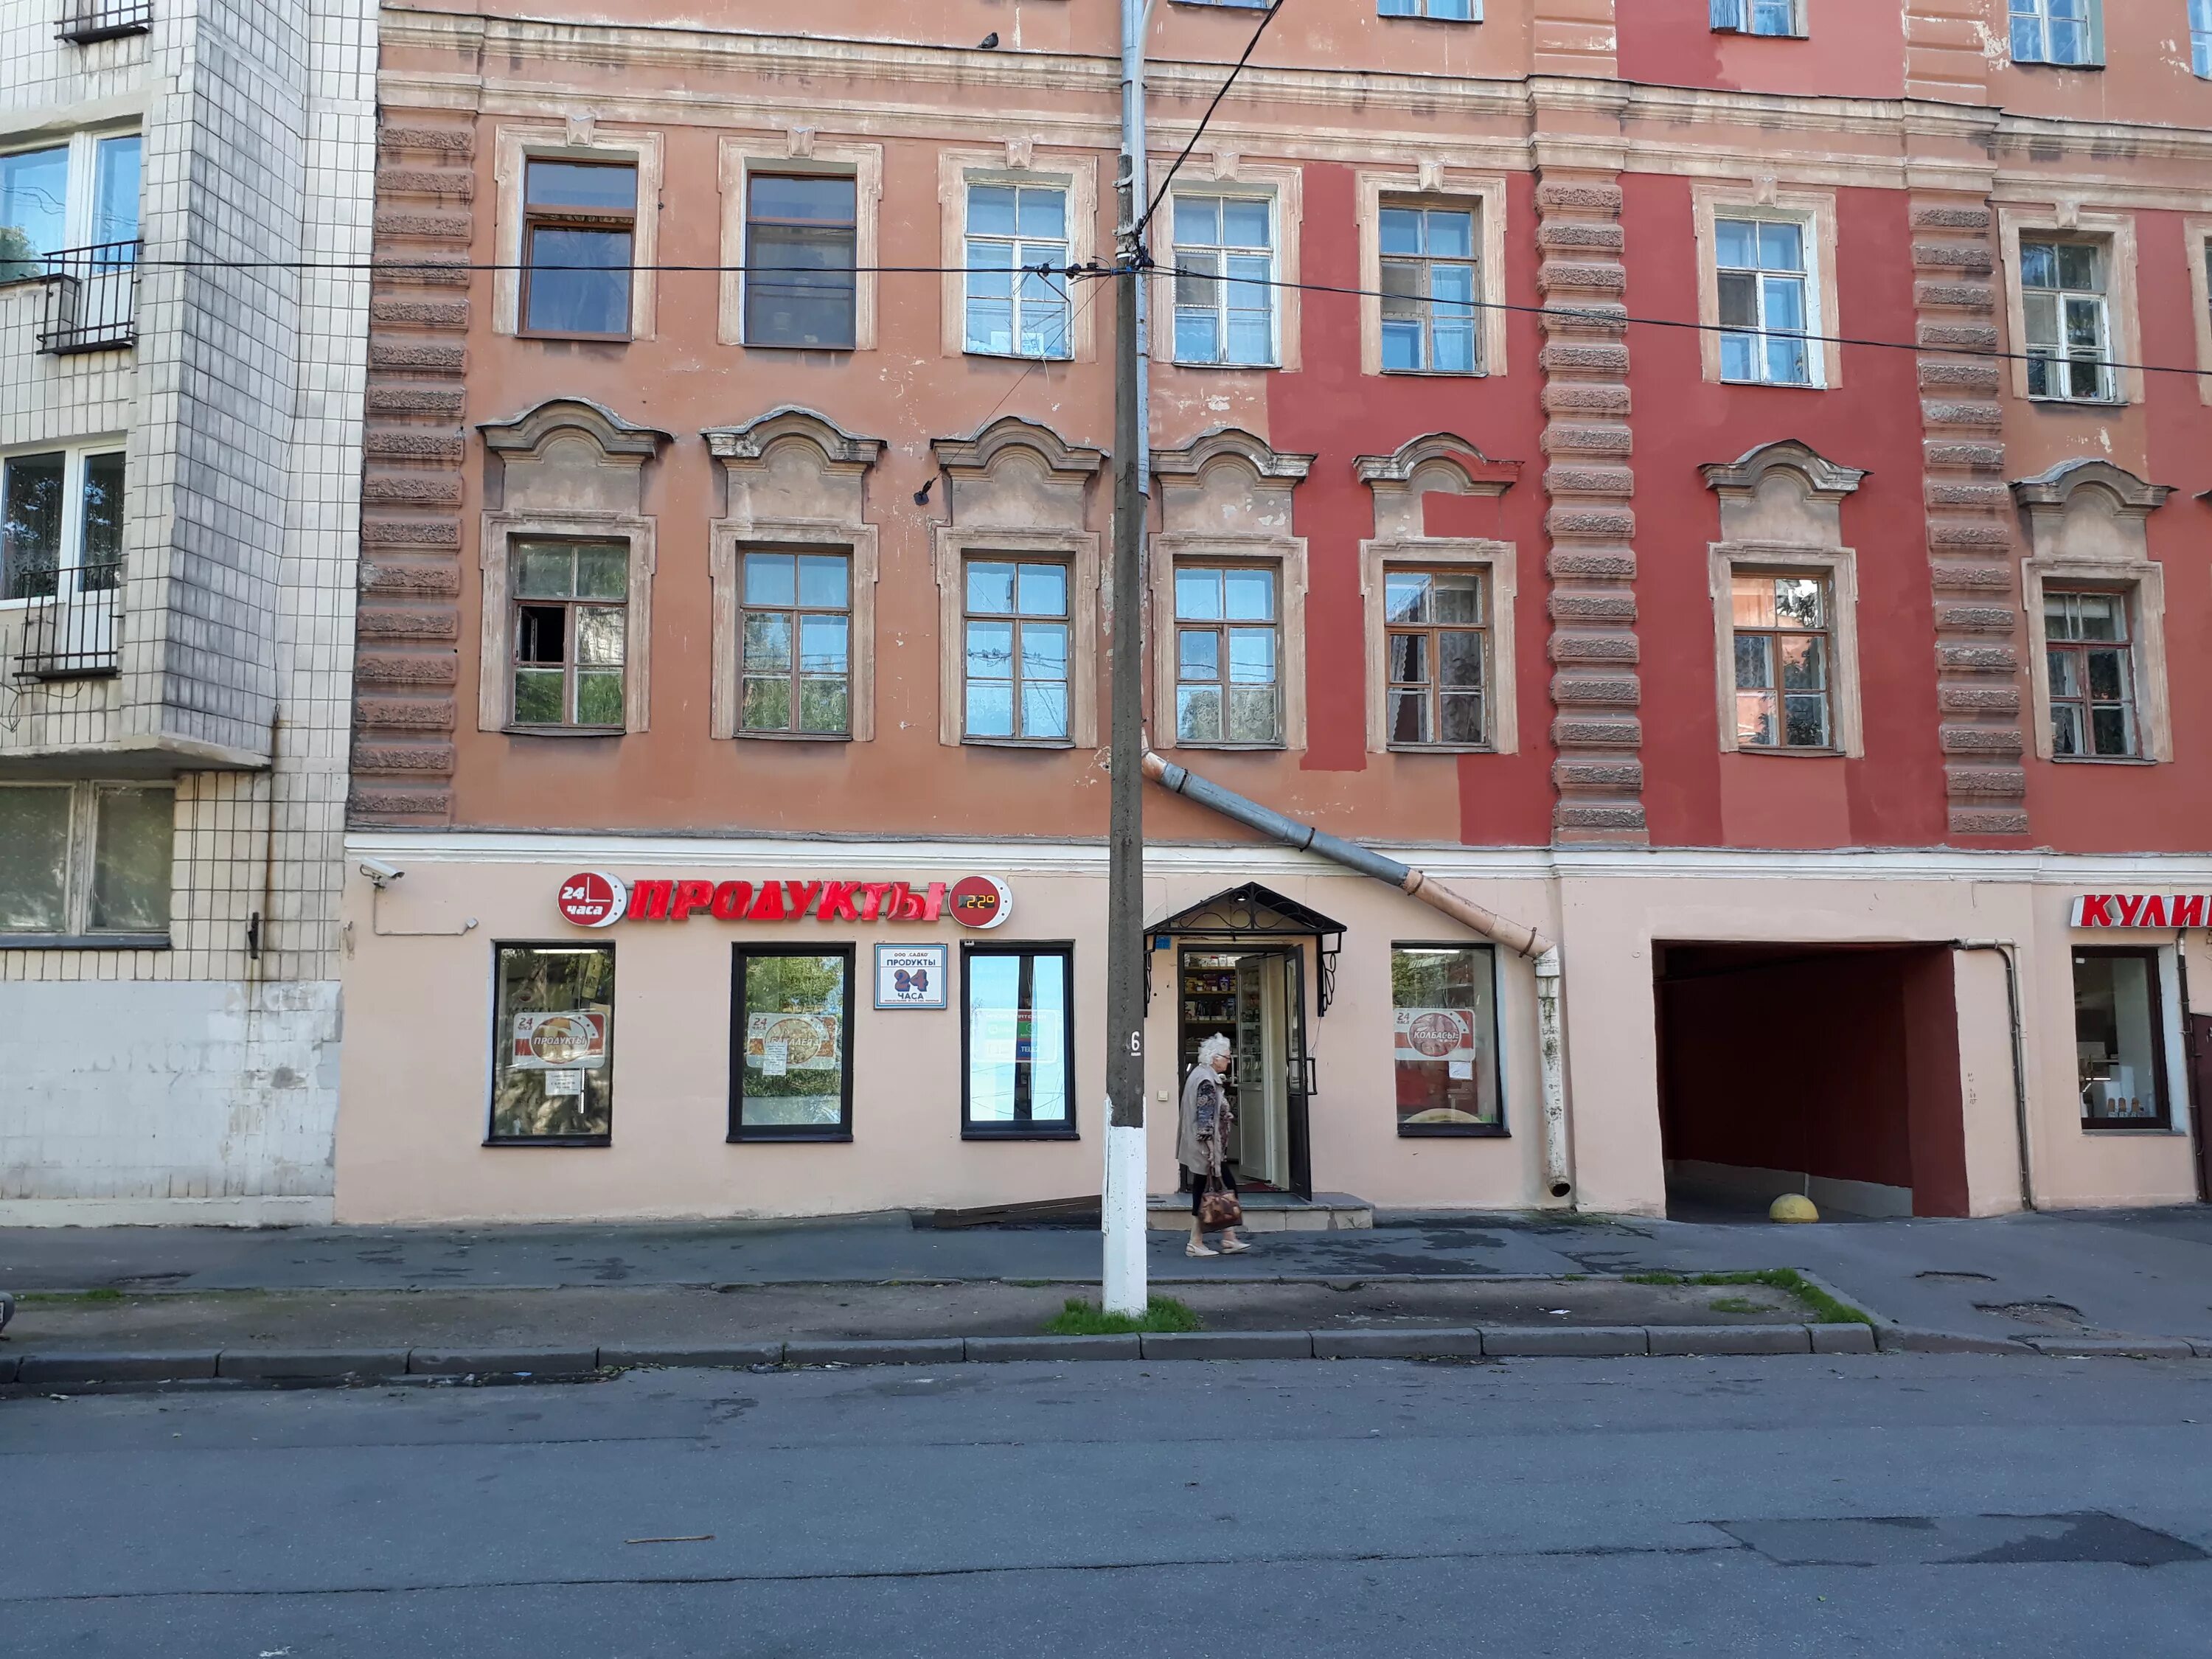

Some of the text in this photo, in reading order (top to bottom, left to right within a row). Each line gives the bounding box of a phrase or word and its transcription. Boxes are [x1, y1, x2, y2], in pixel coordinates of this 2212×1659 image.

[562, 886, 585, 900] 24
[627, 880, 946, 922] ПРОДУКТЫ
[567, 905, 604, 915] часа
[2080, 894, 2212, 927] КУЛИ
[894, 969, 929, 992] 24
[1398, 1012, 1410, 1020] 24
[519, 1018, 533, 1026] 24
[754, 1018, 768, 1026] 24
[1131, 1031, 1140, 1051] 6
[1413, 1032, 1455, 1040] КОЛБАСЫ
[533, 1037, 585, 1046] ПРОДУКТЫ
